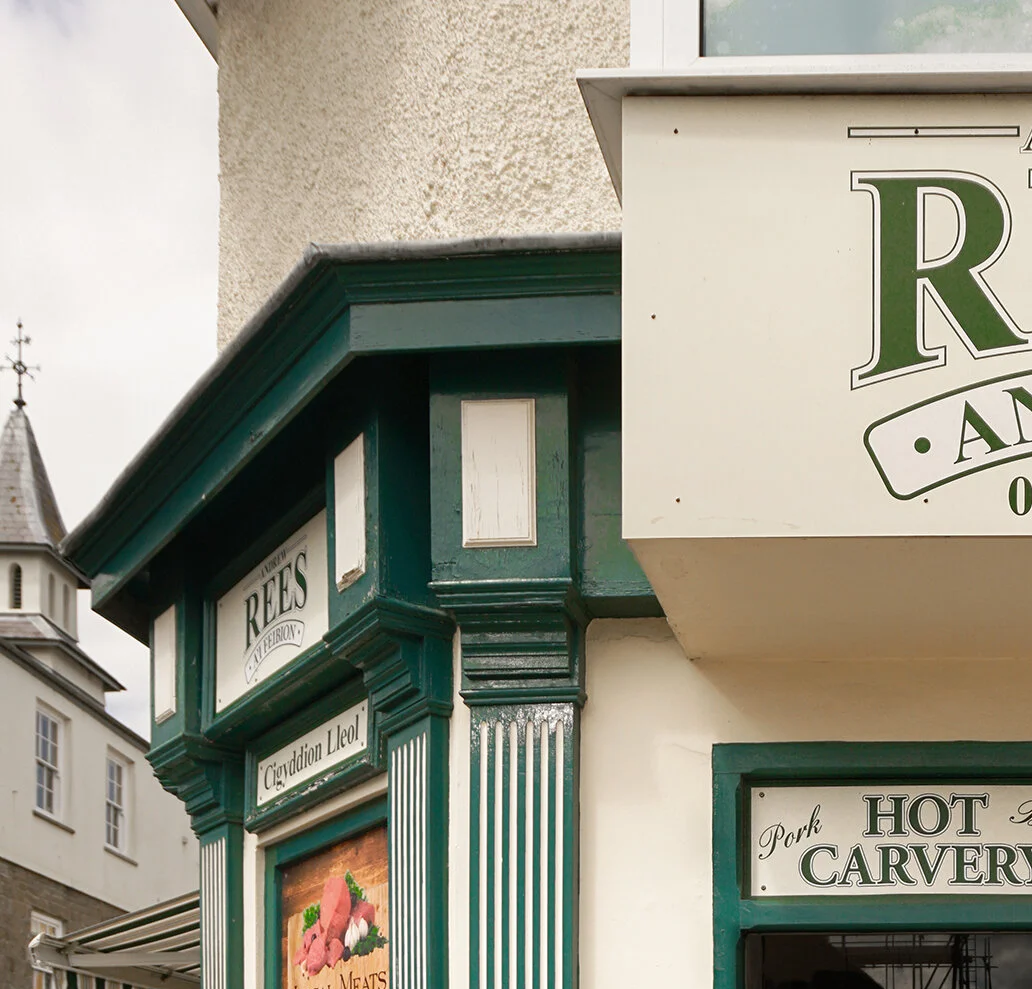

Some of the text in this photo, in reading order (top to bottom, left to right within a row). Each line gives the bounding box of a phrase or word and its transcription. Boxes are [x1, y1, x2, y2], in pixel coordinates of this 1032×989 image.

[244, 544, 308, 655] REES
[264, 714, 359, 791] Cigyddion Lleol
[757, 803, 822, 860] Pork
[863, 792, 990, 839] HOT
